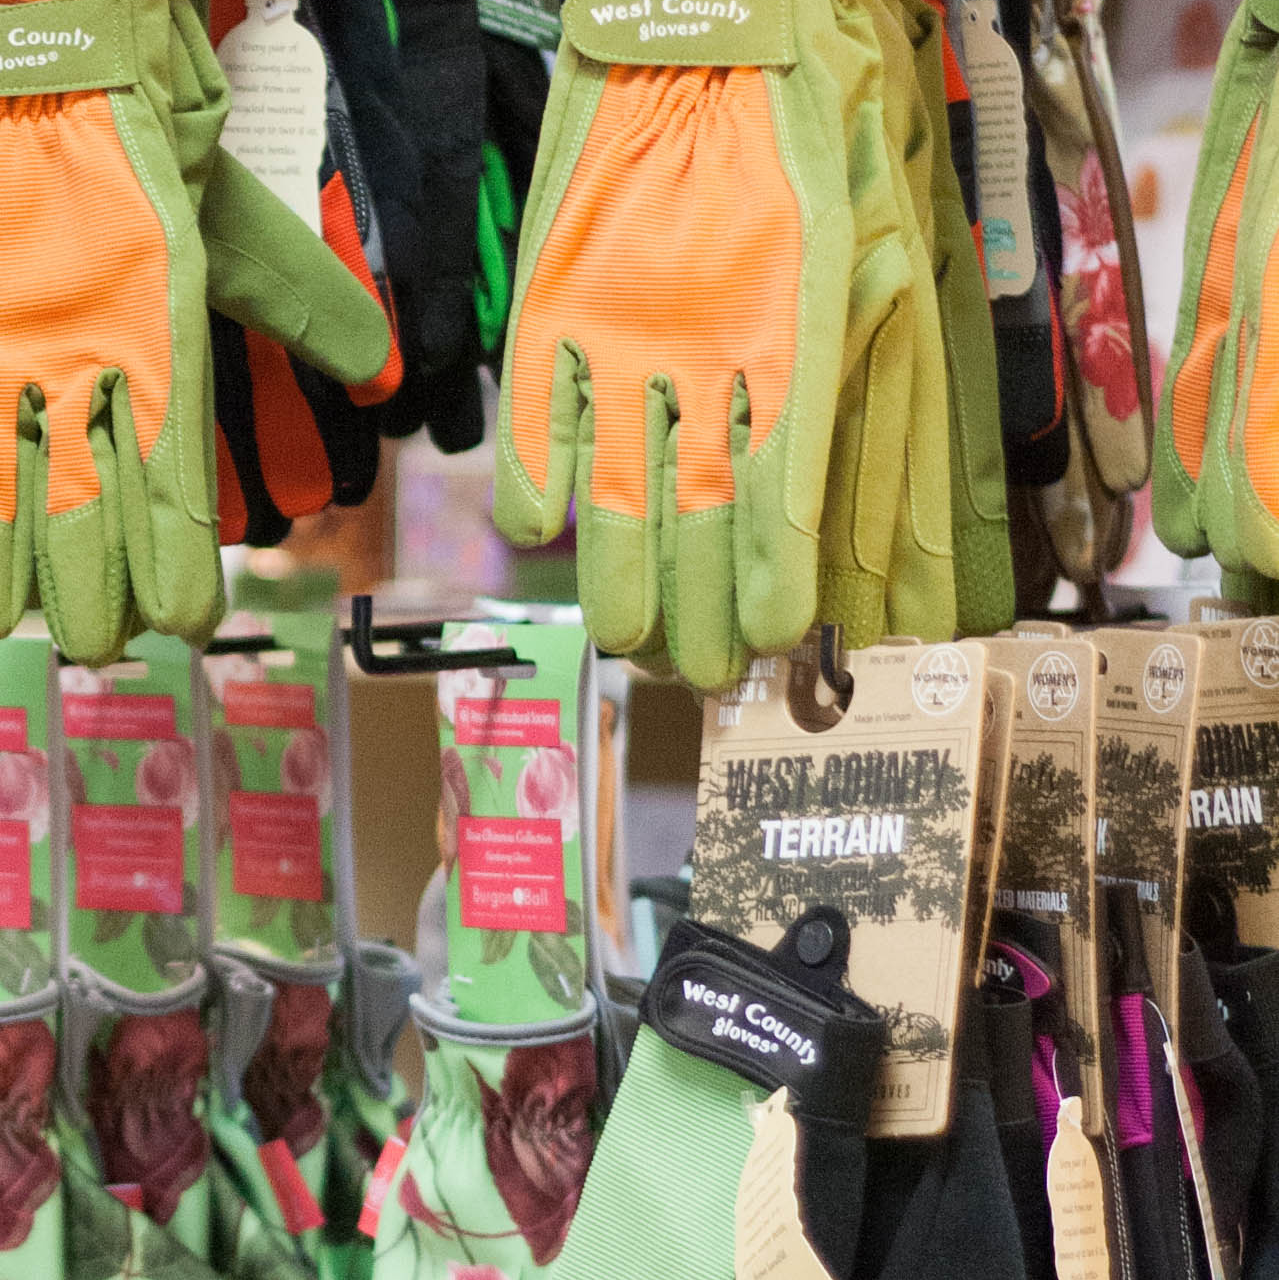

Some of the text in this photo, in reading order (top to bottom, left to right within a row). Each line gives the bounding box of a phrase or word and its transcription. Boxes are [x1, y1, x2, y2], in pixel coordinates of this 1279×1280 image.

[590, 0, 652, 26] West
[8, 26, 95, 52] County
[913, 672, 969, 684] WOMEN'S
[932, 692, 943, 705] L
[726, 748, 952, 812] WEST COUNTY
[1186, 785, 1263, 828] RAIN
[760, 814, 905, 860] TERRAIN
[1016, 890, 1069, 913] MATERIALS
[682, 979, 817, 1066] West County
